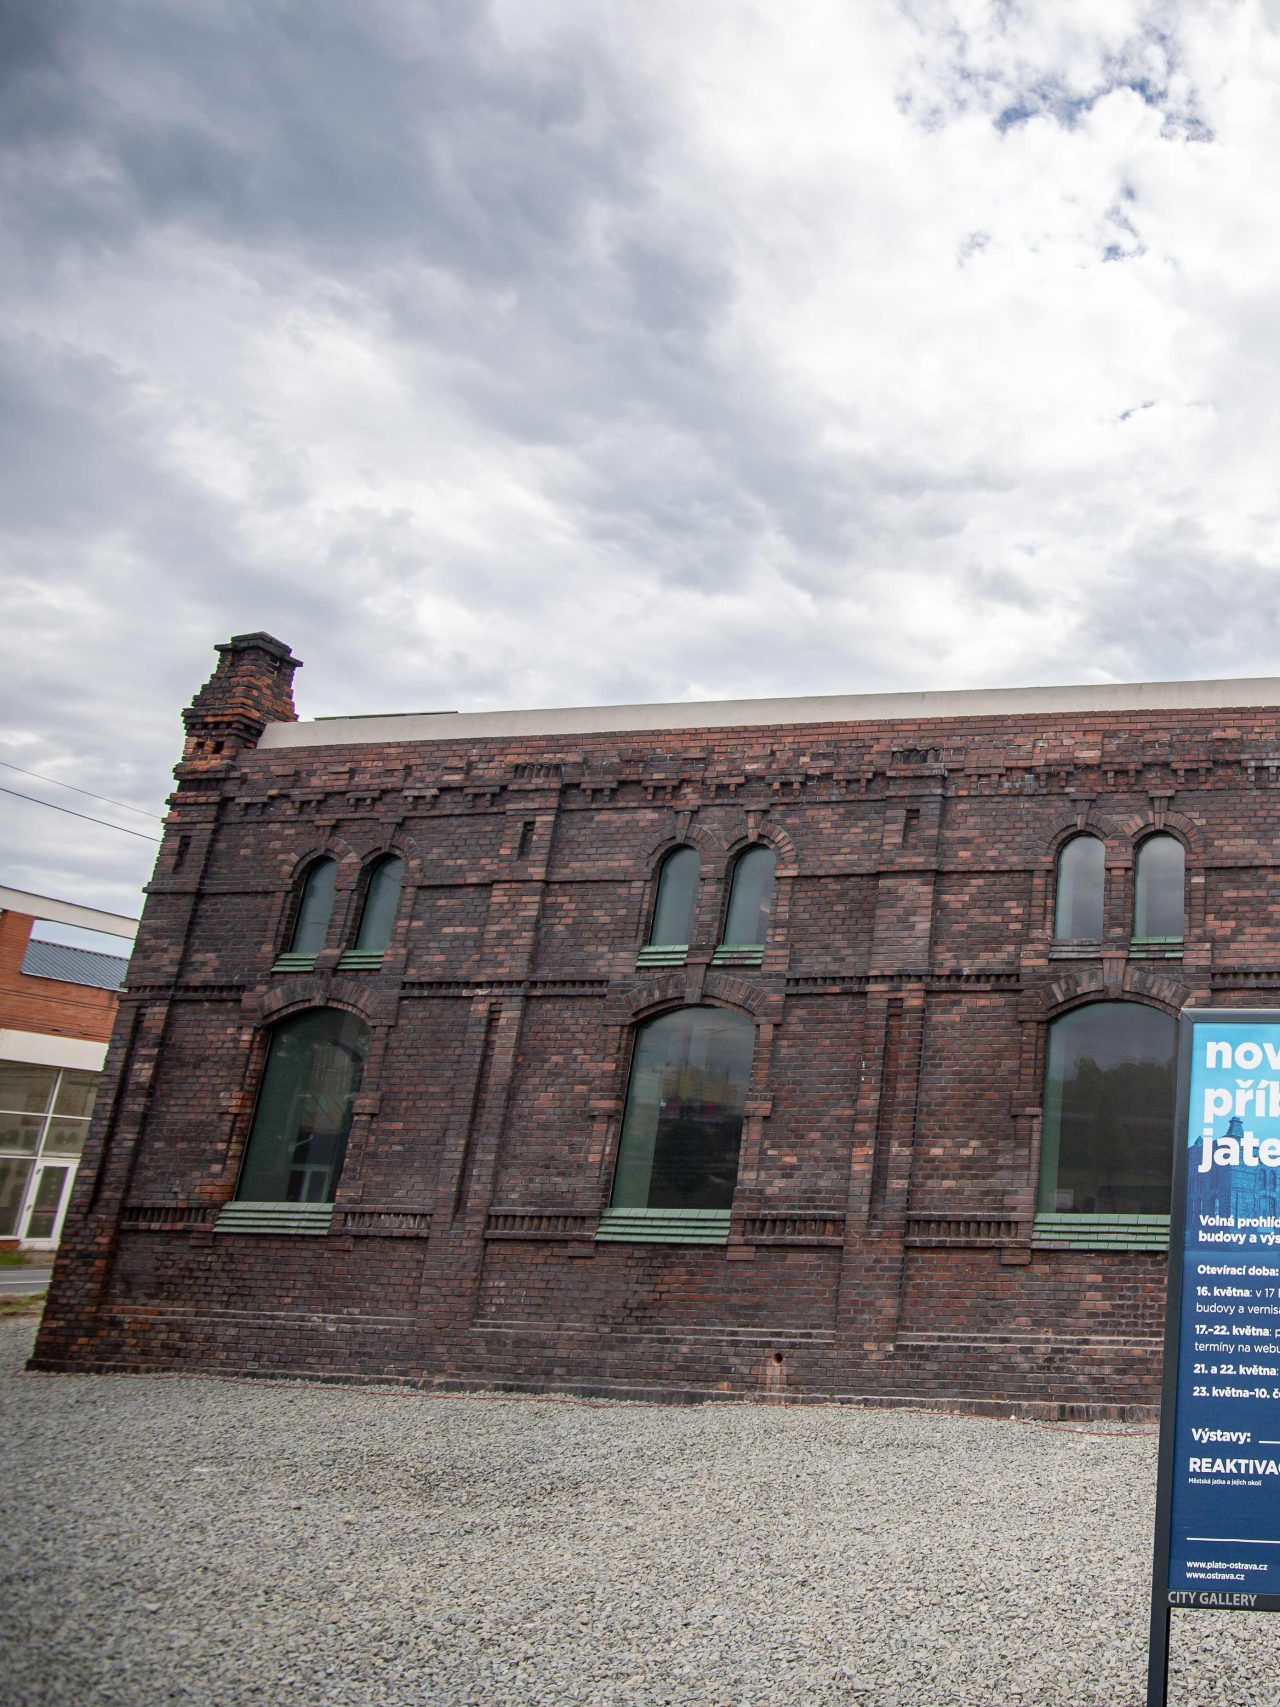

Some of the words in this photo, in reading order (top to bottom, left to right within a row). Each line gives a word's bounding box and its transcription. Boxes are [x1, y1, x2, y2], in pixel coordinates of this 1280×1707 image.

[1199, 1215, 1234, 1227] Volná
[1198, 1231, 1246, 1245] budovy
[1249, 1234, 1257, 1243] a
[1197, 1265, 1246, 1275] Otevírací
[1248, 1266, 1280, 1276] doba:
[1196, 1286, 1211, 1297] 16.
[1213, 1287, 1252, 1298] května:
[1255, 1290, 1262, 1298] v
[1264, 1288, 1275, 1298] 17
[1196, 1302, 1236, 1315] budovy
[1238, 1305, 1245, 1313] a
[1232, 1325, 1272, 1337] května:
[1194, 1342, 1235, 1354] termíny
[1237, 1344, 1251, 1352] na
[1193, 1363, 1208, 1374] 21.
[1210, 1366, 1218, 1374] a
[1219, 1364, 1237, 1375] 22.
[1239, 1365, 1279, 1376] května:
[1192, 1386, 1210, 1397] 23.
[1191, 1428, 1251, 1445] Výstavy:
[1186, 1560, 1268, 1571] www.plato-ostrava.cz
[1186, 1572, 1245, 1581] www.ostrava.cz
[1167, 1591, 1197, 1604] CITY
[1199, 1592, 1258, 1607] GALLERY
